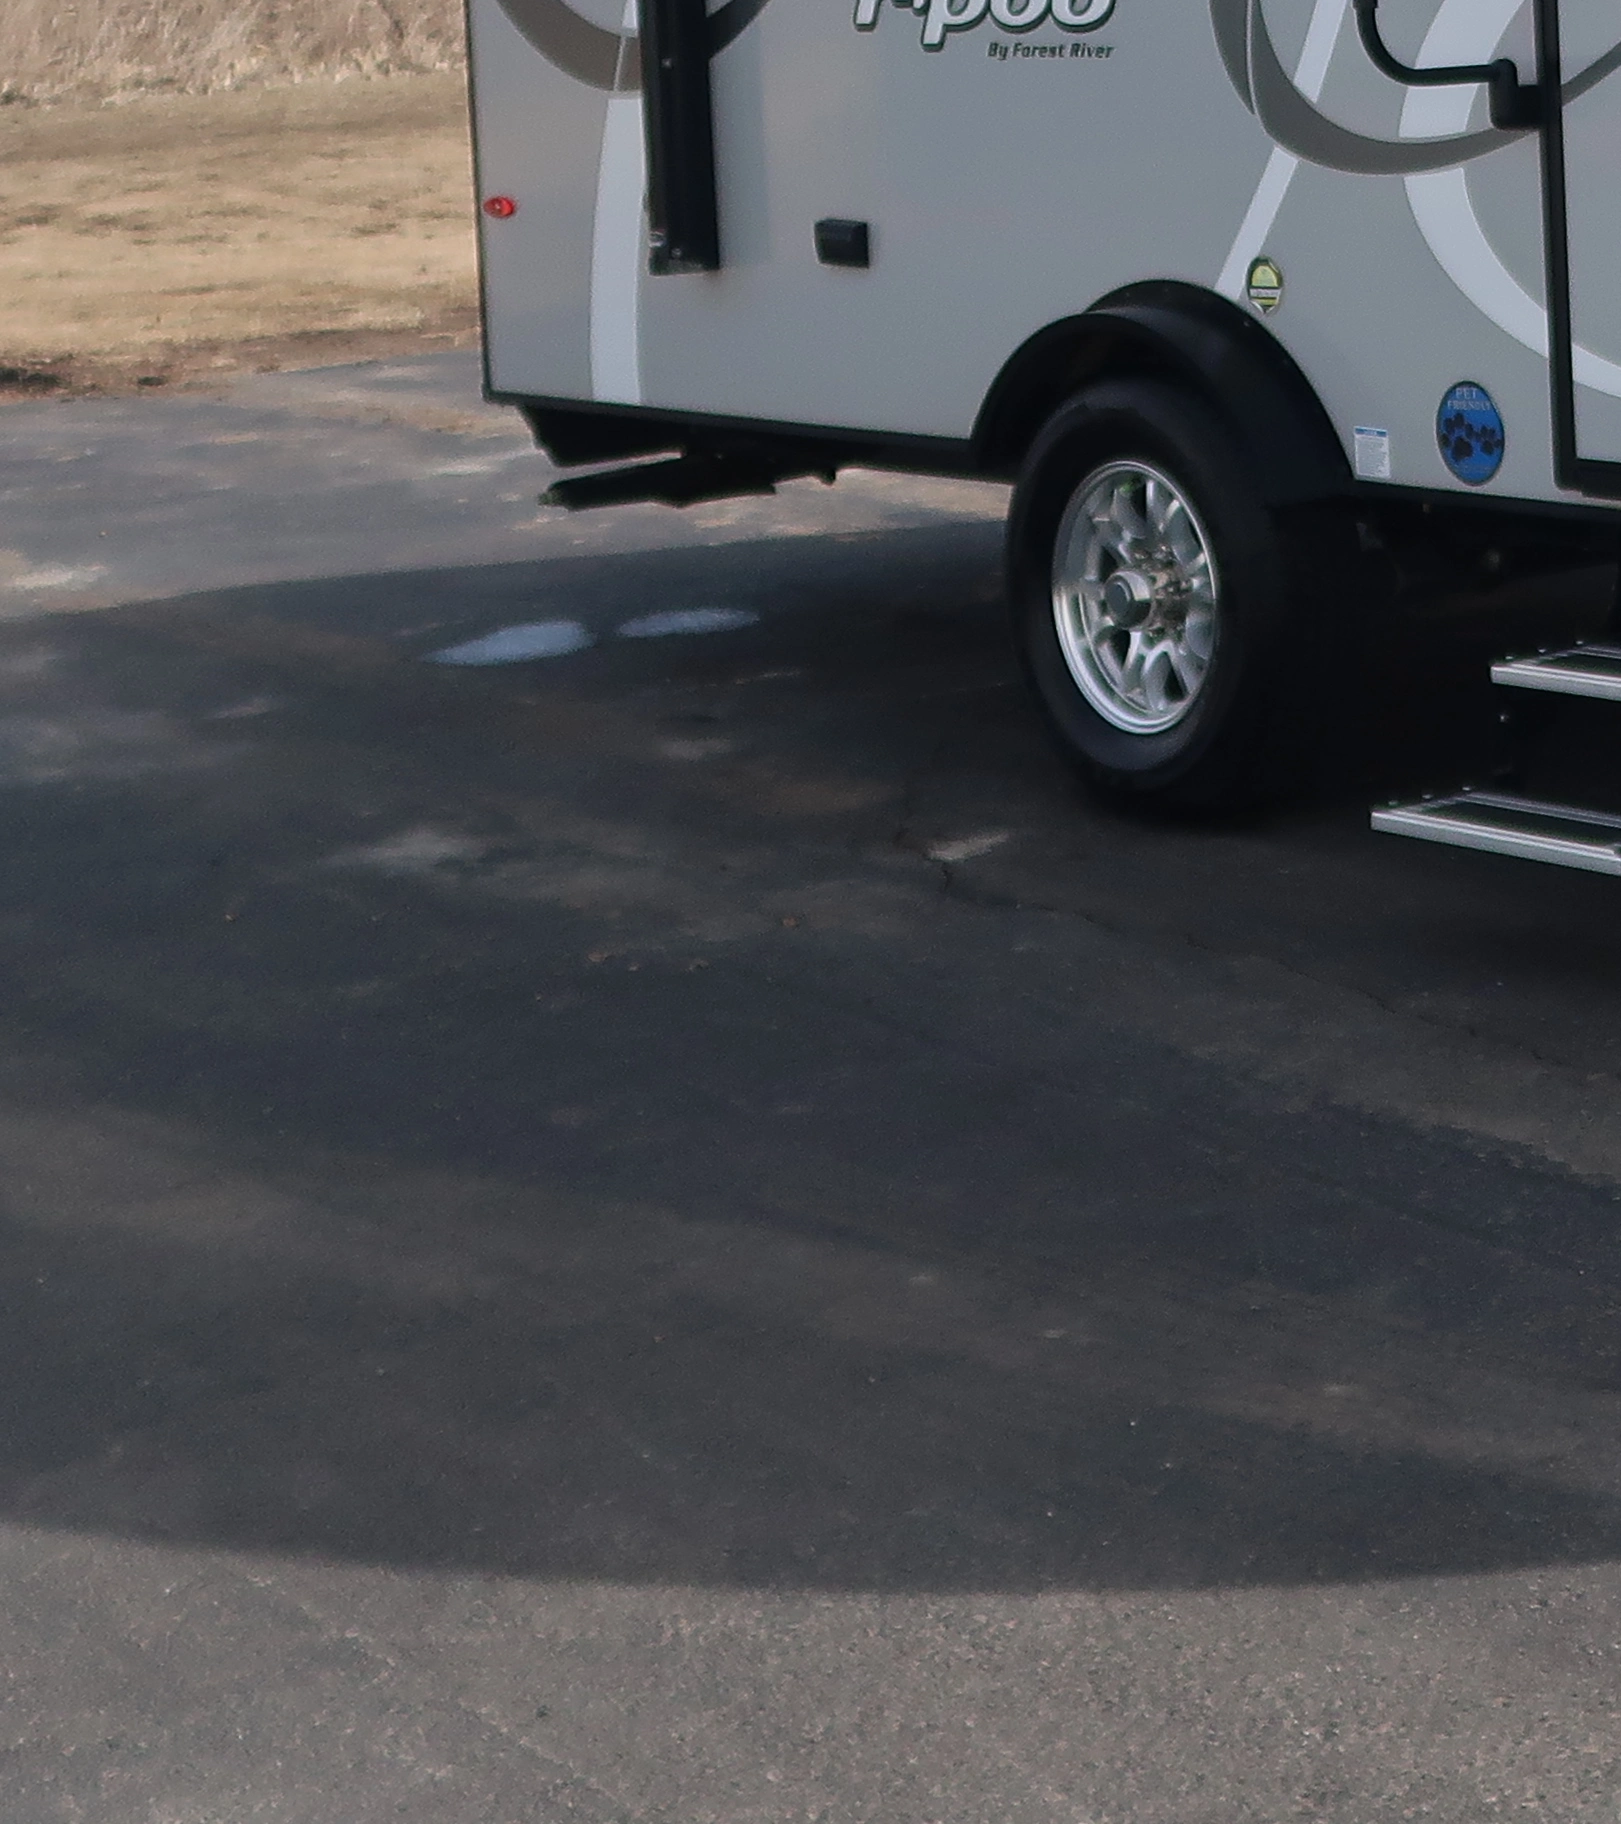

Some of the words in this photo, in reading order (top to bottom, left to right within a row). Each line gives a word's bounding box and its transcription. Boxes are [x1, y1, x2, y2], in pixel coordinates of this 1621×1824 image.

[987, 42, 1008, 60] By
[1012, 42, 1065, 59] Forest
[1069, 42, 1115, 59] River
[1455, 388, 1478, 399] PET
